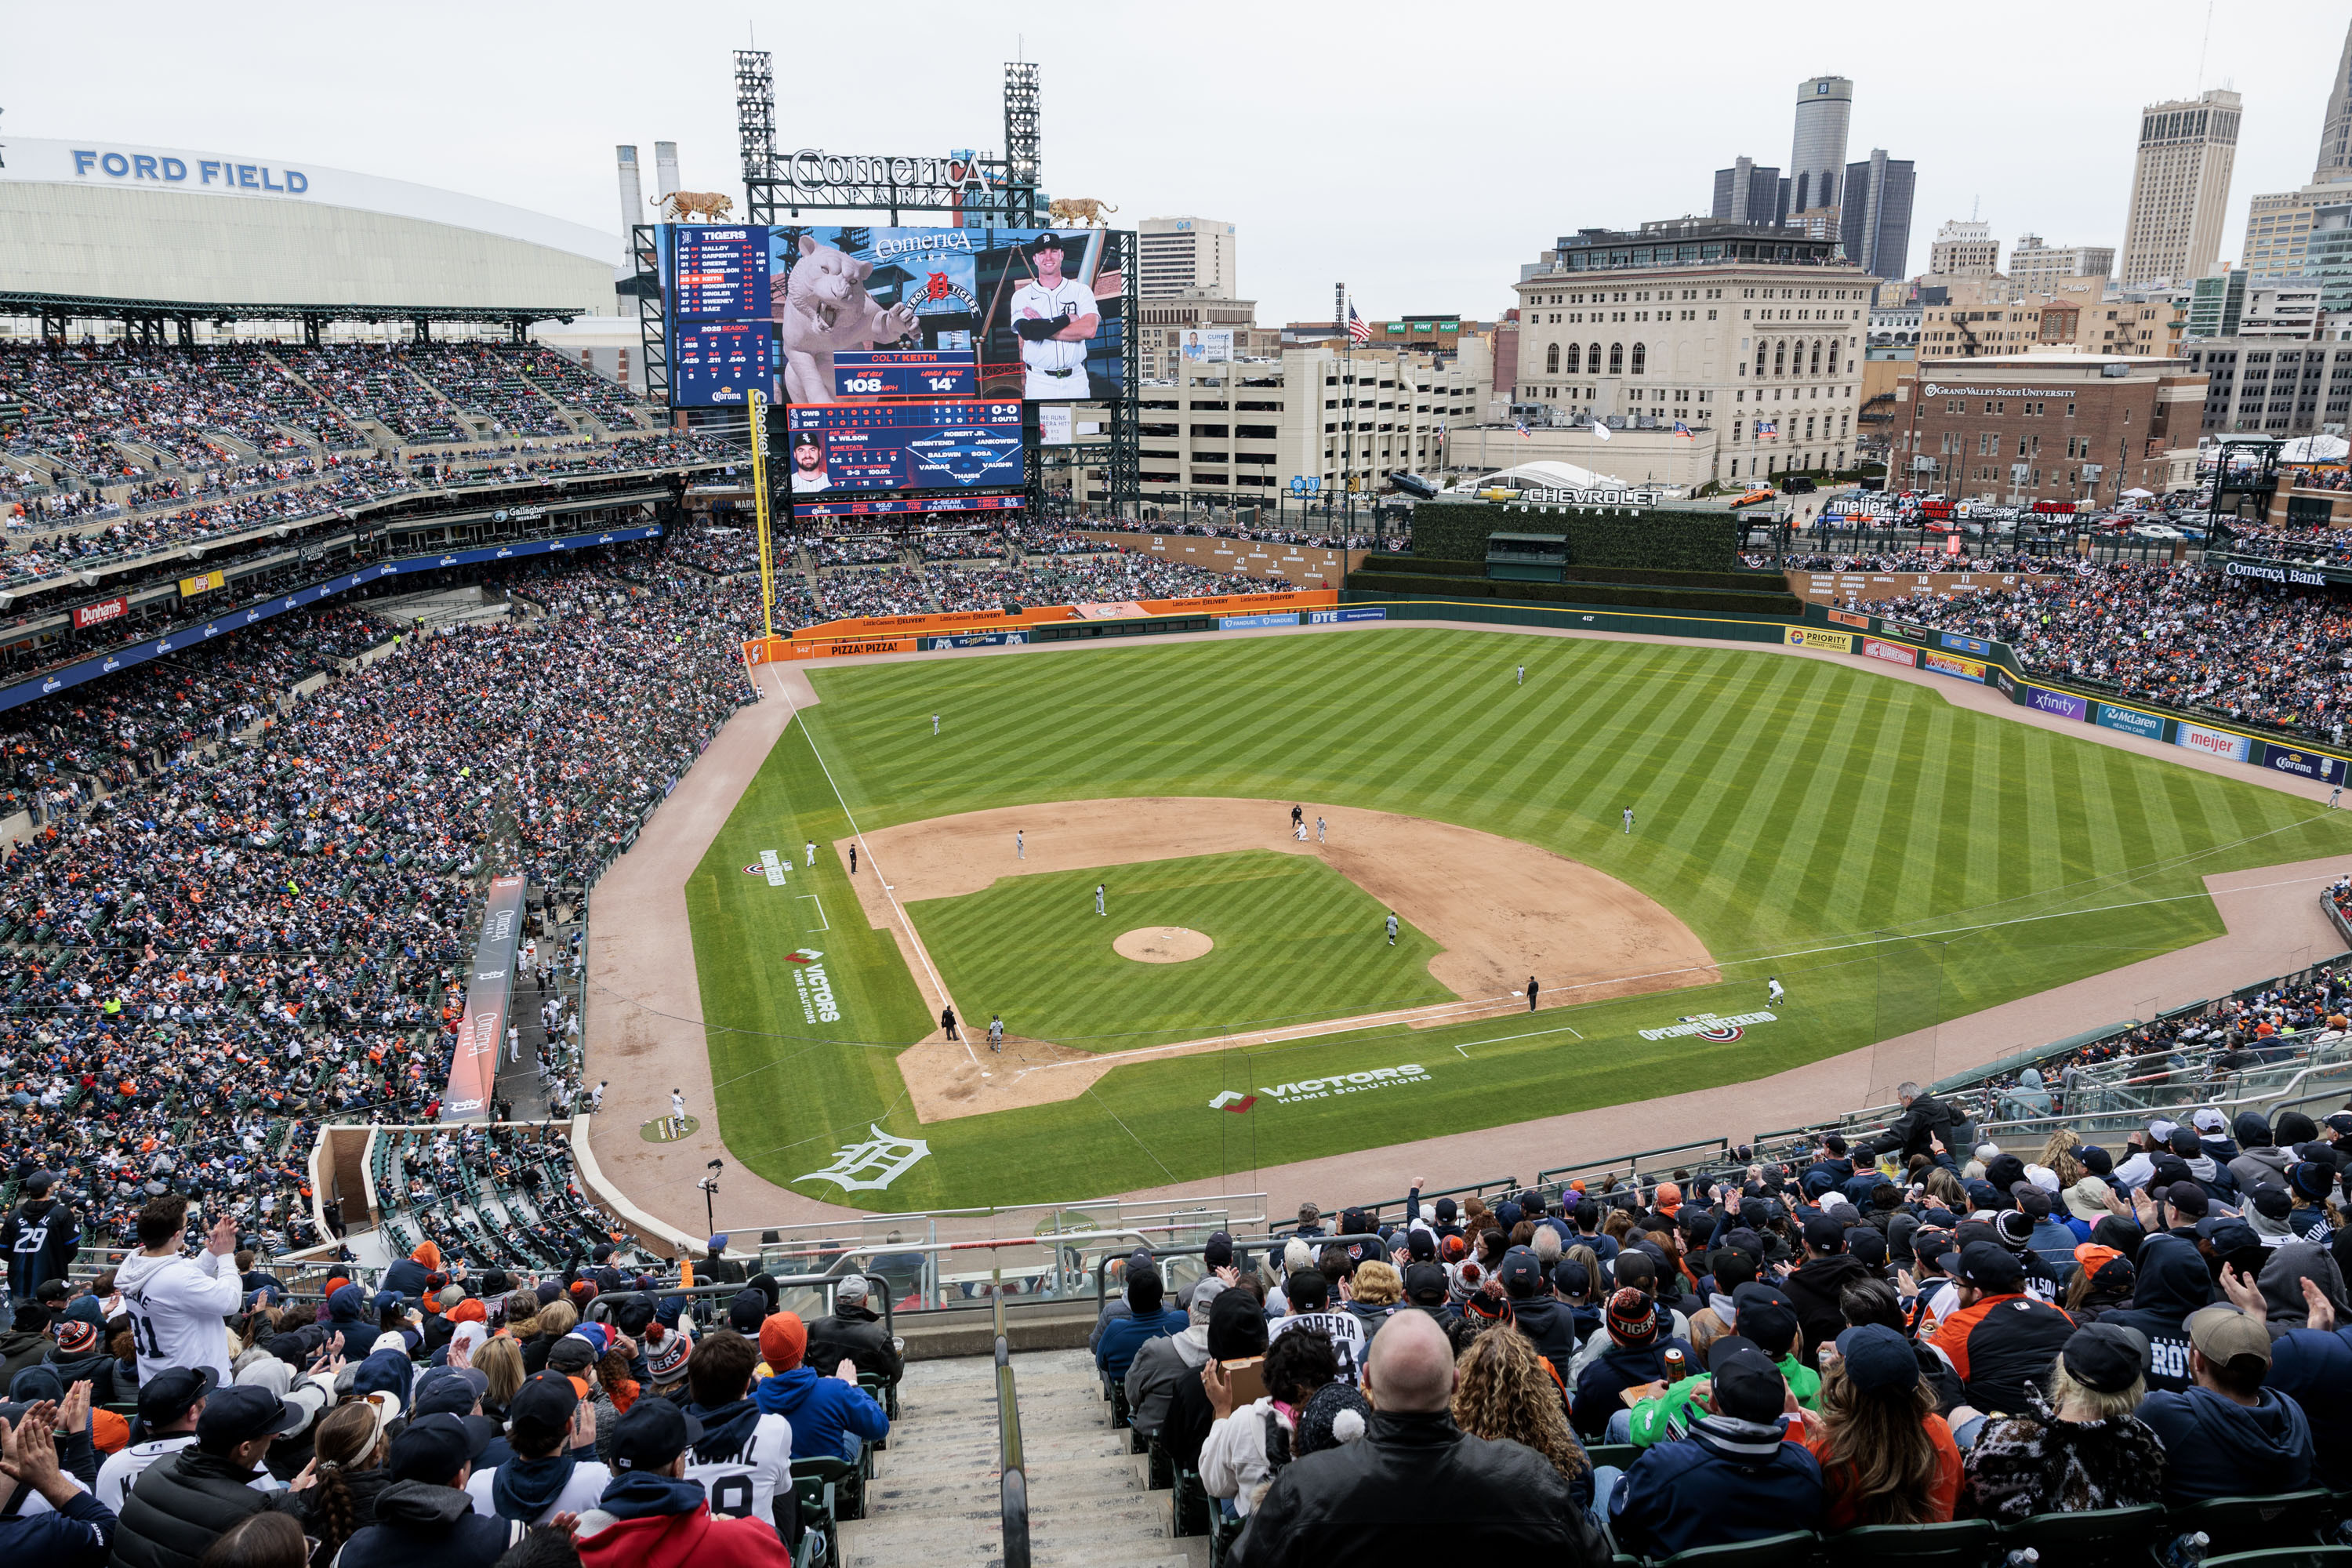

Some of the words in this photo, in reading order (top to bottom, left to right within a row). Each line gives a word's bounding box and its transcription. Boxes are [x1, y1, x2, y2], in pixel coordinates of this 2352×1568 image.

[71, 150, 187, 181] FORD
[197, 159, 308, 194] FIELD
[847, 188, 941, 205] PARK
[702, 230, 746, 241] TIGERS
[905, 252, 947, 264] PARK
[2065, 283, 2091, 294] Ashley
[871, 354, 900, 363] COLT
[902, 353, 938, 362] KEITH
[844, 379, 882, 393] 108
[928, 377, 956, 391] 14°
[1936, 386, 1965, 395] GRAND
[1965, 387, 1996, 396] VALLEY
[1996, 387, 2021, 397] STATE
[2022, 388, 2076, 397] UNIVERSITY
[712, 391, 741, 403] Corona
[991, 405, 1017, 415] 0-0
[755, 405, 771, 457] Rocket
[1528, 488, 1663, 506] CHEVROLET
[509, 506, 546, 518] Gallagher
[1503, 505, 1639, 517] FOUNTAIN
[1833, 497, 1888, 517] meijer
[1921, 501, 1956, 510] BELLE
[2032, 502, 2077, 514] FIEGER
[1924, 510, 1950, 518] TIRE
[2046, 514, 2074, 524] LAW
[440, 557, 457, 566] Corona
[194, 575, 209, 591] Lay's
[1918, 575, 1928, 585] 10
[1961, 575, 1969, 584] 11
[2002, 575, 2016, 585] 42
[2288, 570, 2327, 586] Bank
[81, 599, 122, 623] Dunham's
[1312, 612, 1338, 623] DTE
[85, 613, 119, 626] SPORTS
[967, 635, 989, 646] Miller
[1806, 633, 1846, 644] PRIORITY
[831, 644, 864, 655] PIZZA!
[866, 642, 898, 653] PIZZA!
[1866, 642, 1880, 655] ABC
[1879, 644, 1913, 665] WAREHOUSE
[1929, 656, 1962, 673] Surfside
[2035, 694, 2075, 715] xfinity
[2118, 711, 2157, 729] McLaren
[2113, 722, 2132, 731] HEALTH
[2132, 727, 2146, 735] CARE
[2190, 732, 2233, 757] meijer
[2275, 756, 2312, 774] Corona
[793, 969, 805, 987] HOME
[804, 963, 840, 1024] VICTORS
[797, 987, 817, 1025] SOLUTIONS
[1638, 1022, 1711, 1041] OPENING
[1700, 1011, 1778, 1030] WEEKEND
[1258, 1063, 1426, 1098] VICTORS
[1278, 1091, 1330, 1104] HOME
[1334, 1074, 1432, 1094] SOLUTIONS
[13, 1228, 49, 1253] 29
[1619, 1308, 1655, 1334] TIGERS
